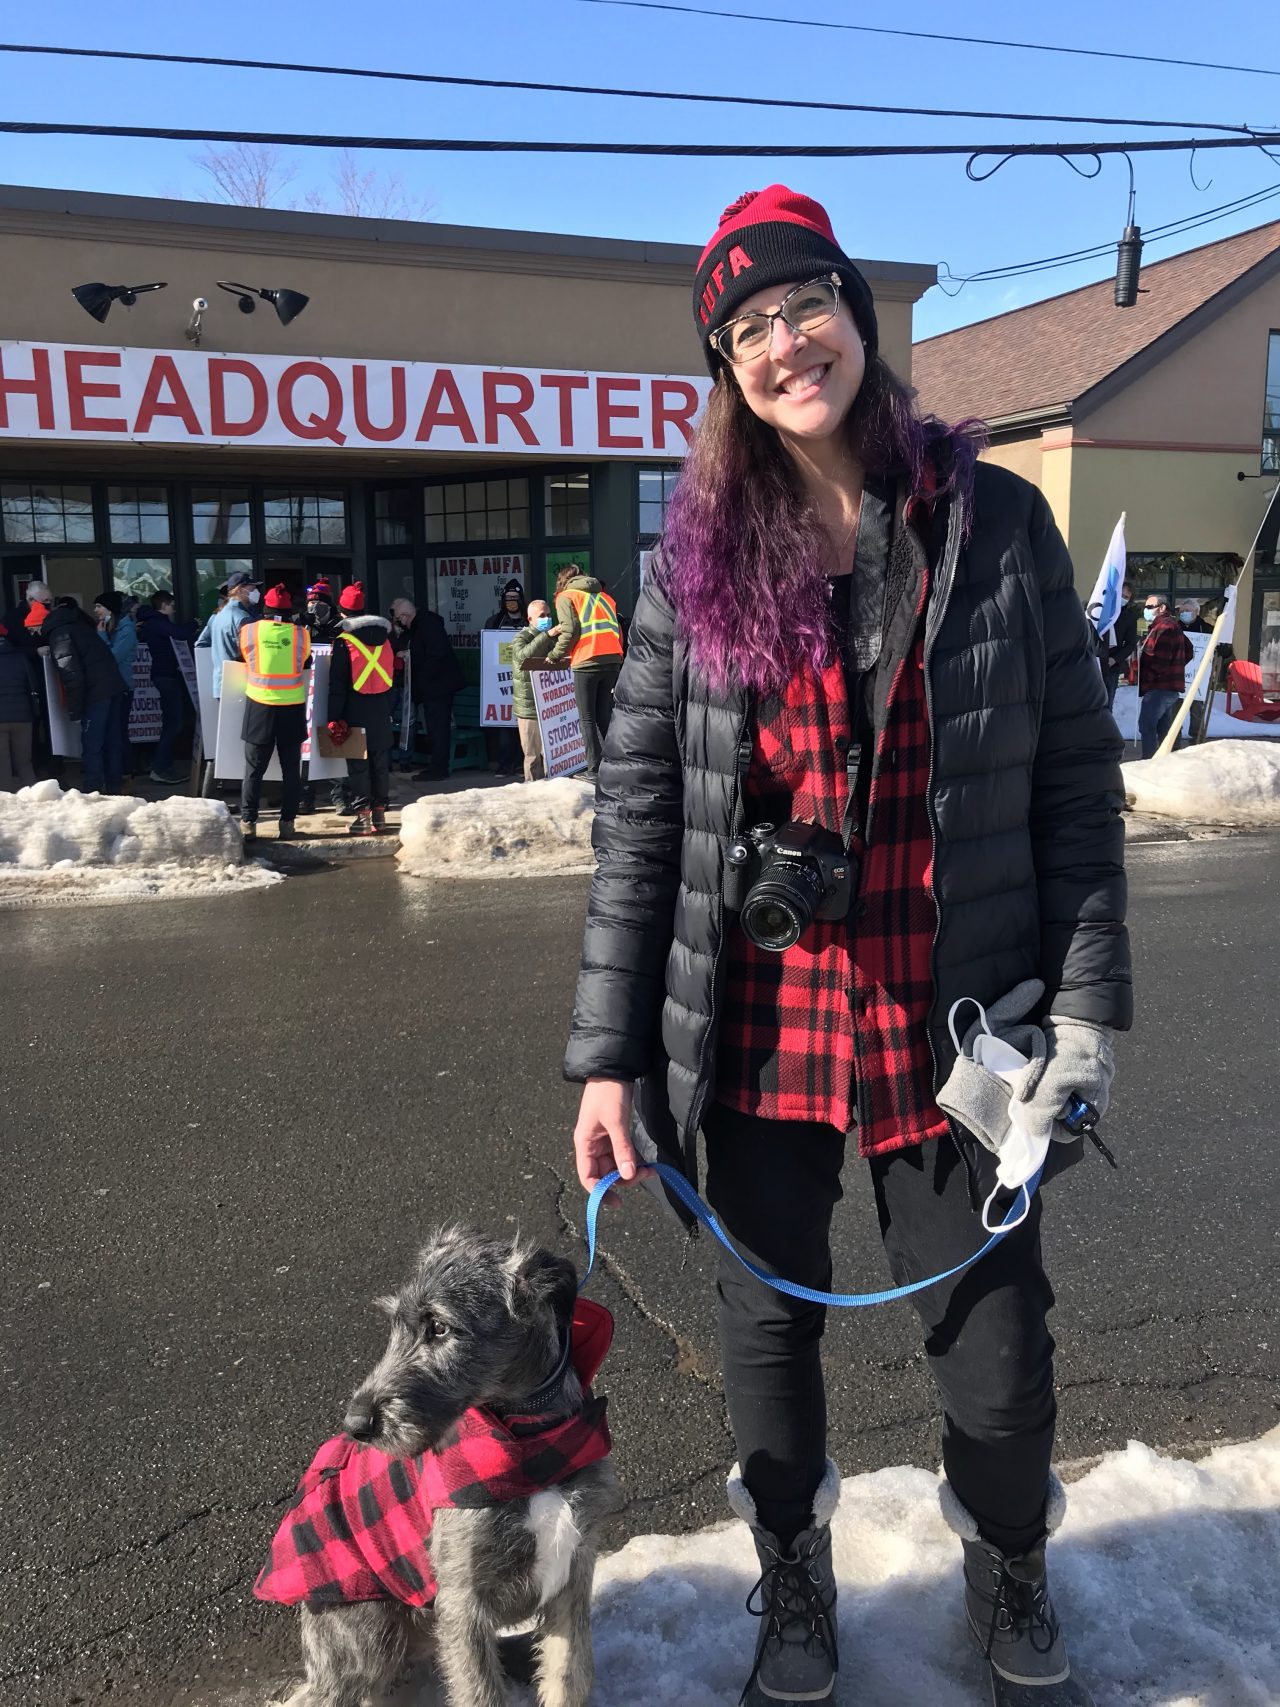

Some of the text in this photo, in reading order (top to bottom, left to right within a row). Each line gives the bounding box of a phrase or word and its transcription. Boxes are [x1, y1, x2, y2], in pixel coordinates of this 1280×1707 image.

[0, 346, 717, 449] HEADQUARTER
[439, 556, 522, 576] AUFA AUFA
[451, 587, 469, 600] Wage
[449, 611, 472, 622] Labour
[539, 667, 572, 689] FACULTY
[542, 682, 575, 703] WORKING
[541, 698, 577, 720] CONDITION
[550, 751, 587, 776] CONDITION
[776, 847, 802, 857] Canon
